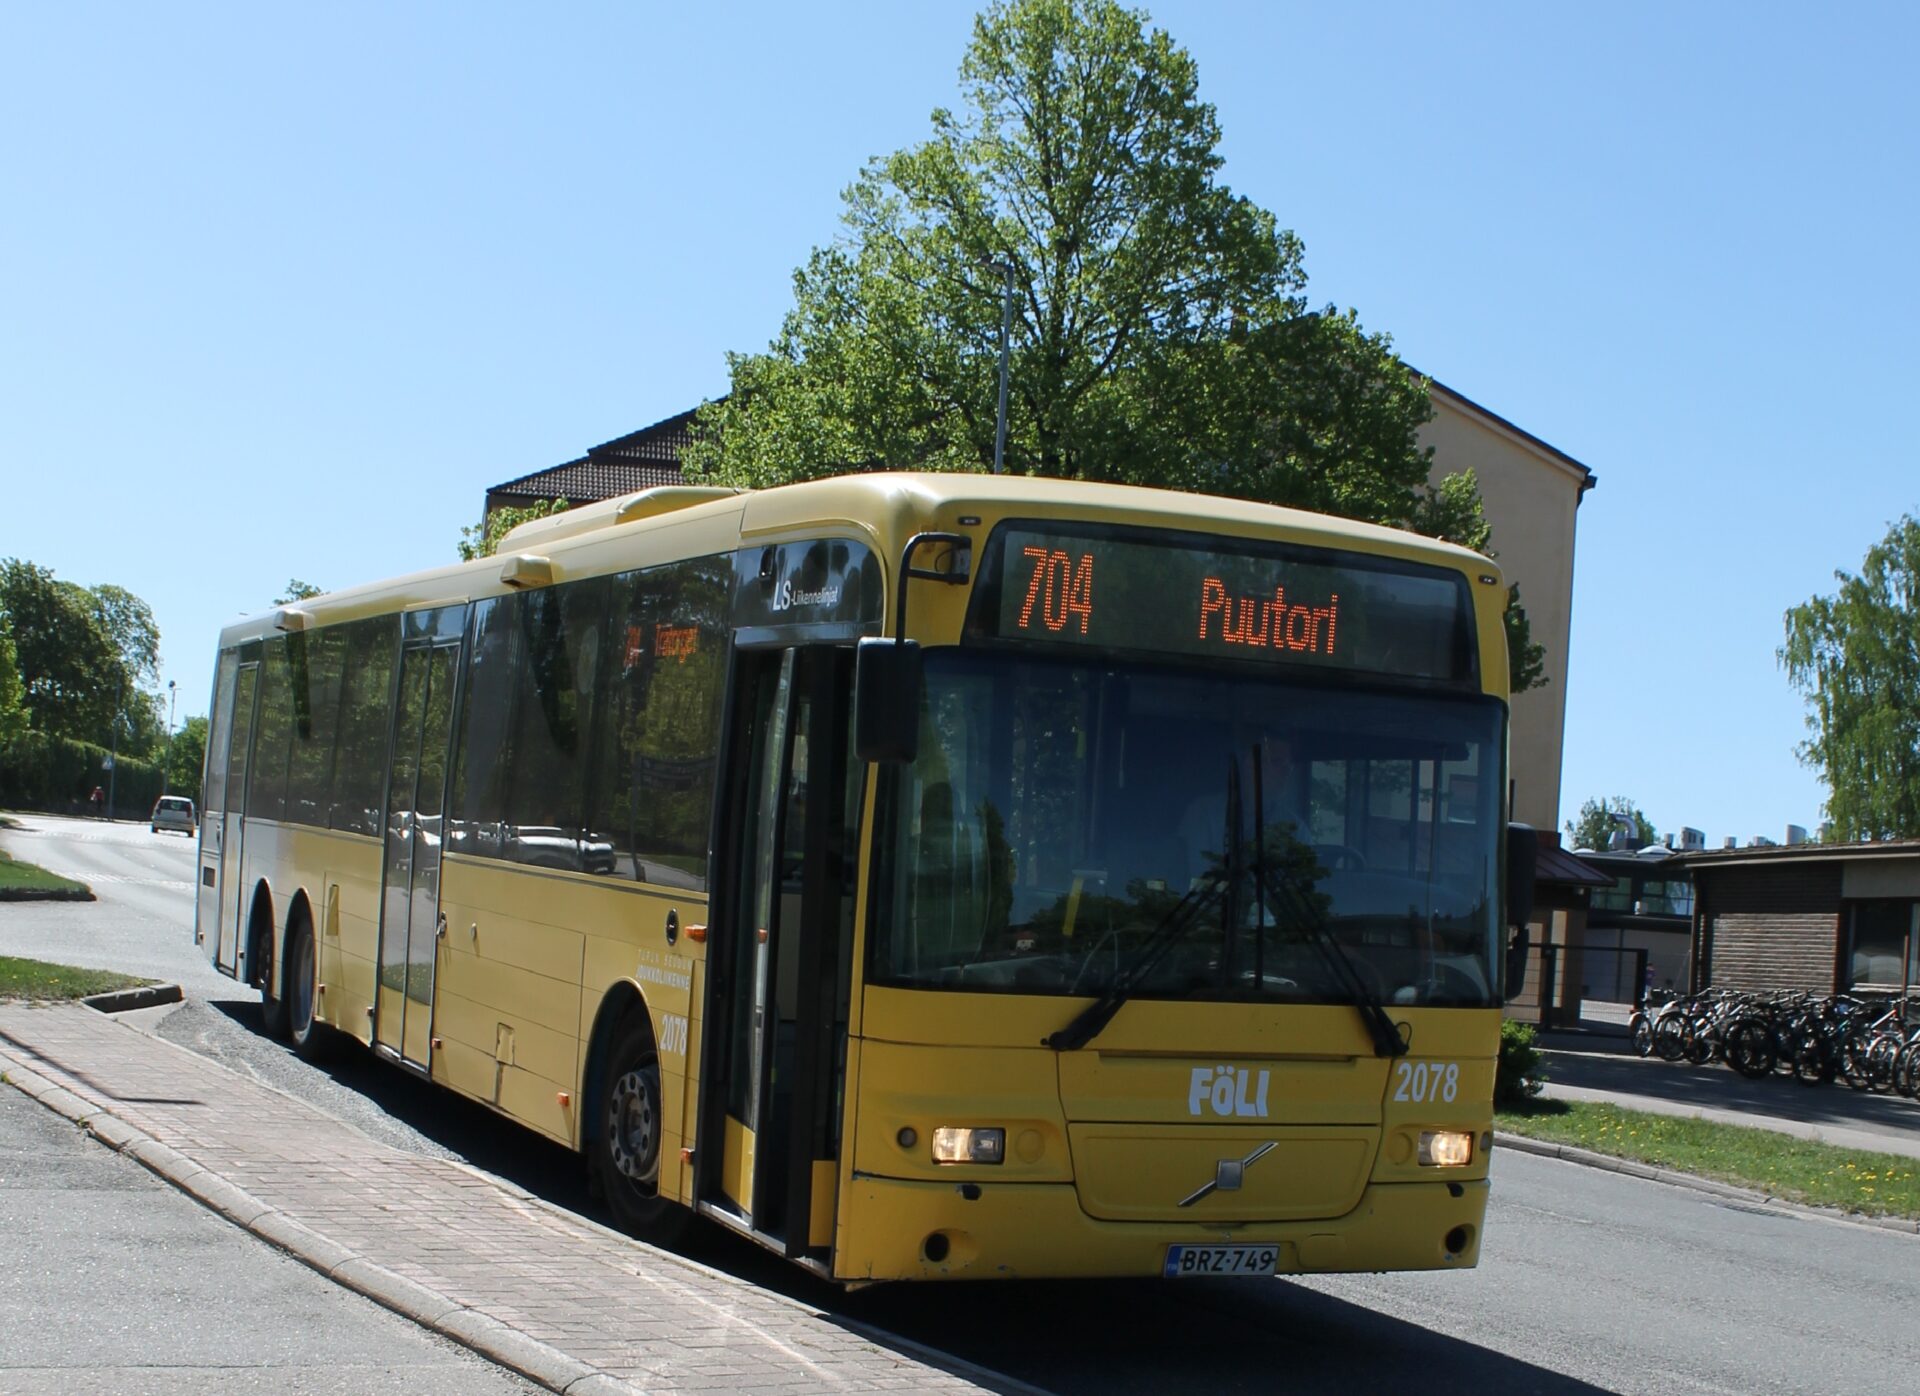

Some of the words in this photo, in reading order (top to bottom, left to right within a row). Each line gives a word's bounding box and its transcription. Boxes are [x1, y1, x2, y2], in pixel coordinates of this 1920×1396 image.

[1018, 547, 1093, 634] 704
[1198, 577, 1337, 654] Puutori
[660, 1015, 688, 1056] 2078
[1394, 1063, 1458, 1102] 2078
[1182, 1250, 1273, 1272] BRZ-749
